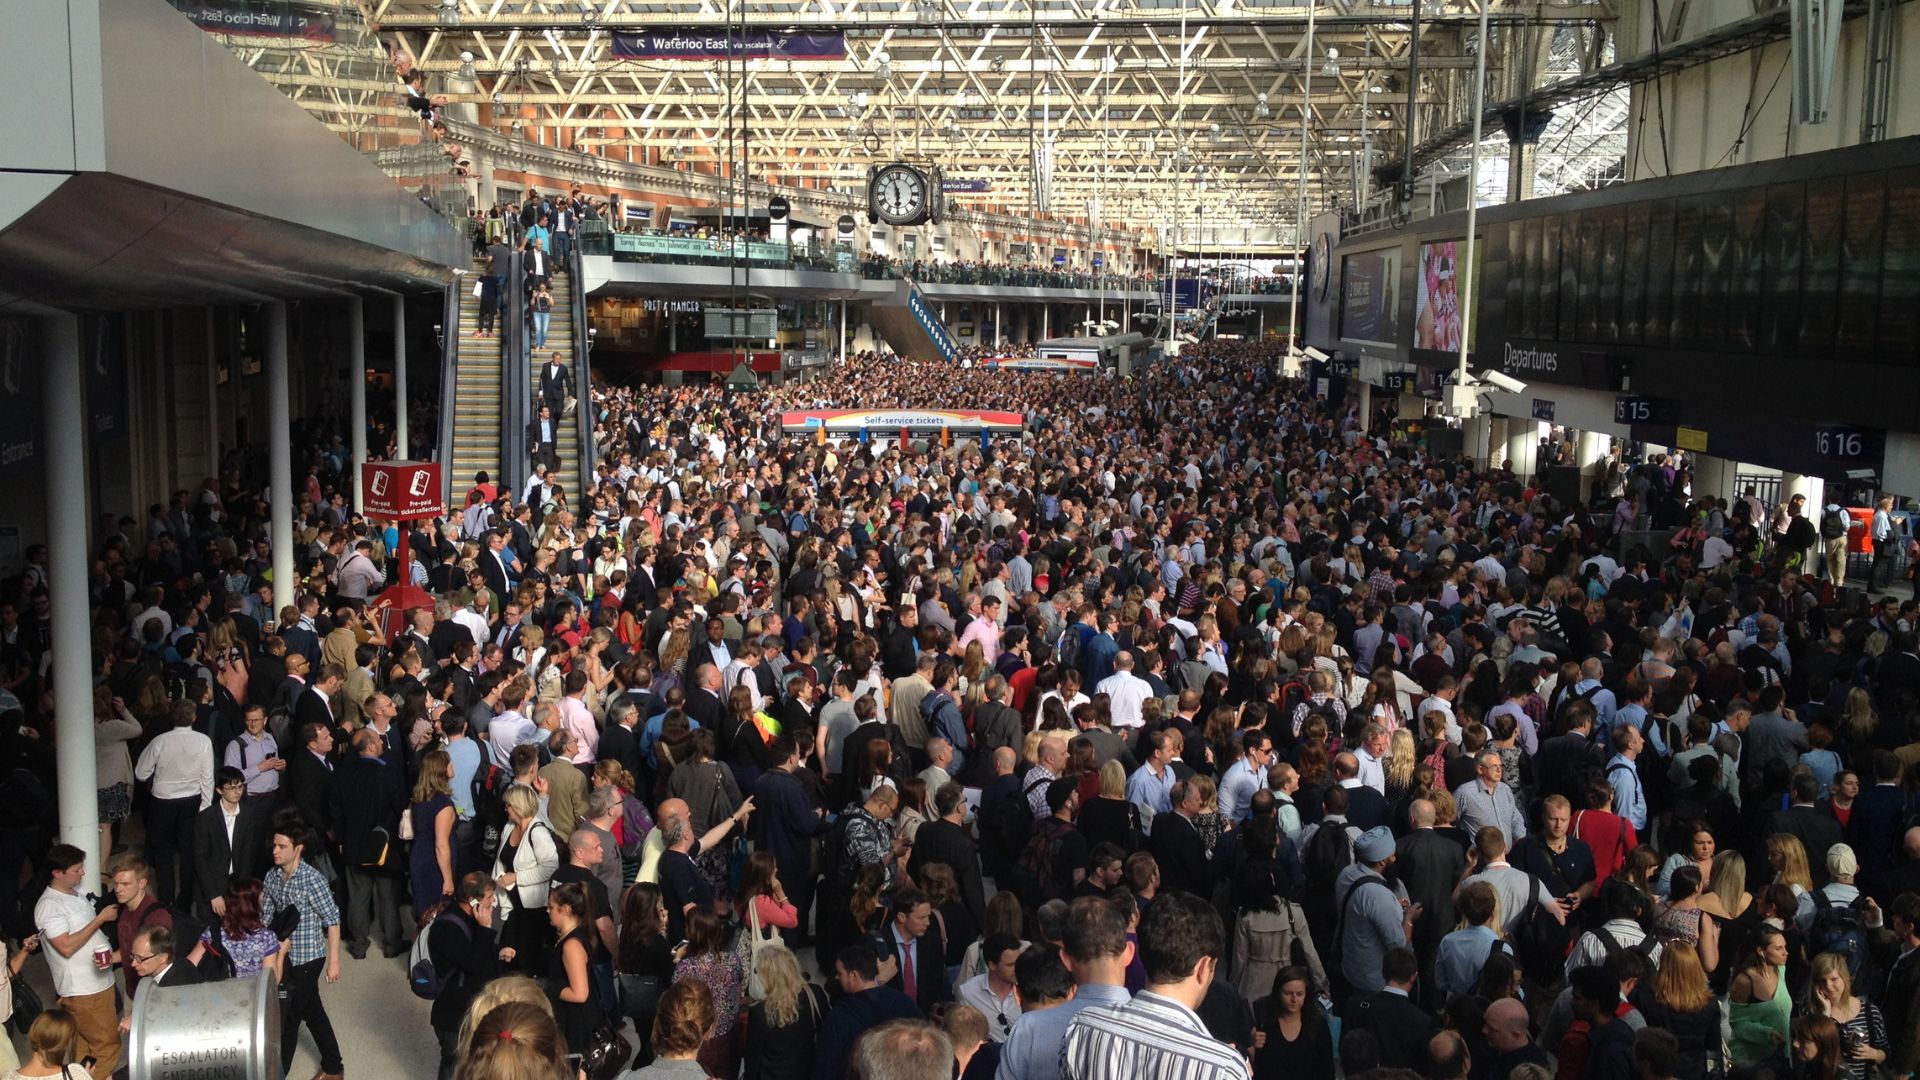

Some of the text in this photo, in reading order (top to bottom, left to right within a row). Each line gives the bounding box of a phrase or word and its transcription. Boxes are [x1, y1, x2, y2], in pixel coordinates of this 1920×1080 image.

[653, 37, 703, 49] Waterloo
[705, 38, 729, 49] East
[643, 300, 661, 312] PRET
[671, 300, 700, 312] MANGER
[1503, 341, 1558, 373] Departures
[1388, 376, 1402, 388] 13
[1630, 401, 1650, 420] 15
[864, 416, 945, 426] Self-service tickets
[1815, 431, 1862, 456] 16 16
[2, 440, 34, 464] Entrance
[409, 498, 432, 507] Pre-paid
[401, 505, 441, 516] ticket collection
[162, 1046, 238, 1066] ESCALATOR
[162, 1064, 238, 1080] EMERGENCY
